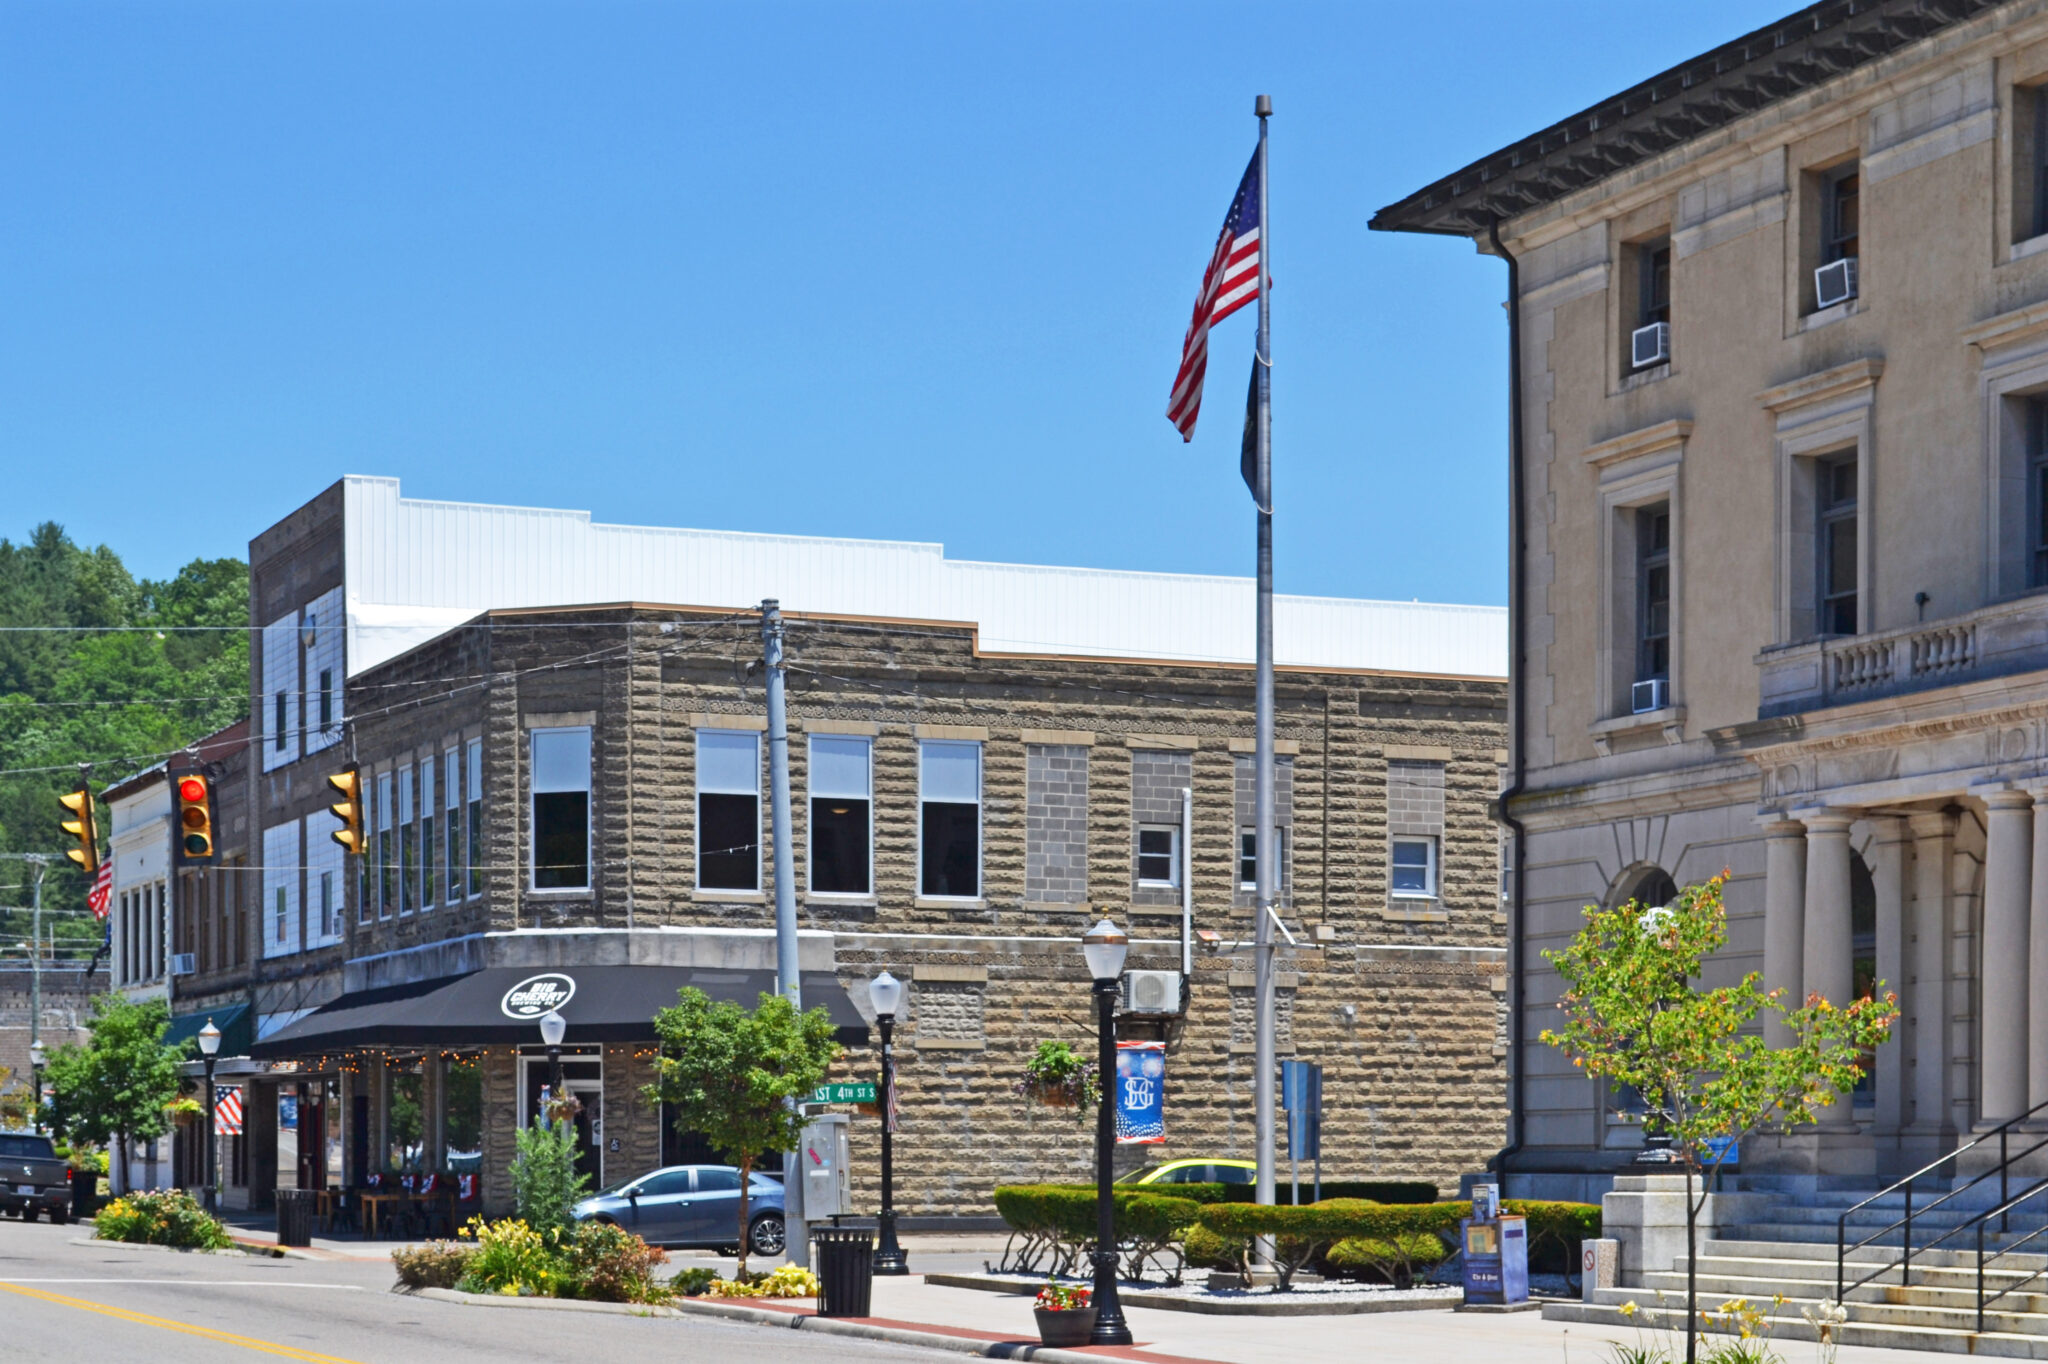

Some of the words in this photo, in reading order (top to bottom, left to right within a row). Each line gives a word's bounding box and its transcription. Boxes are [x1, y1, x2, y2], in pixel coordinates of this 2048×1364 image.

[530, 983, 557, 992] BIG
[510, 991, 567, 1002] CHERRY
[837, 1086, 853, 1100] 4TH
[857, 1088, 865, 1098] ST
